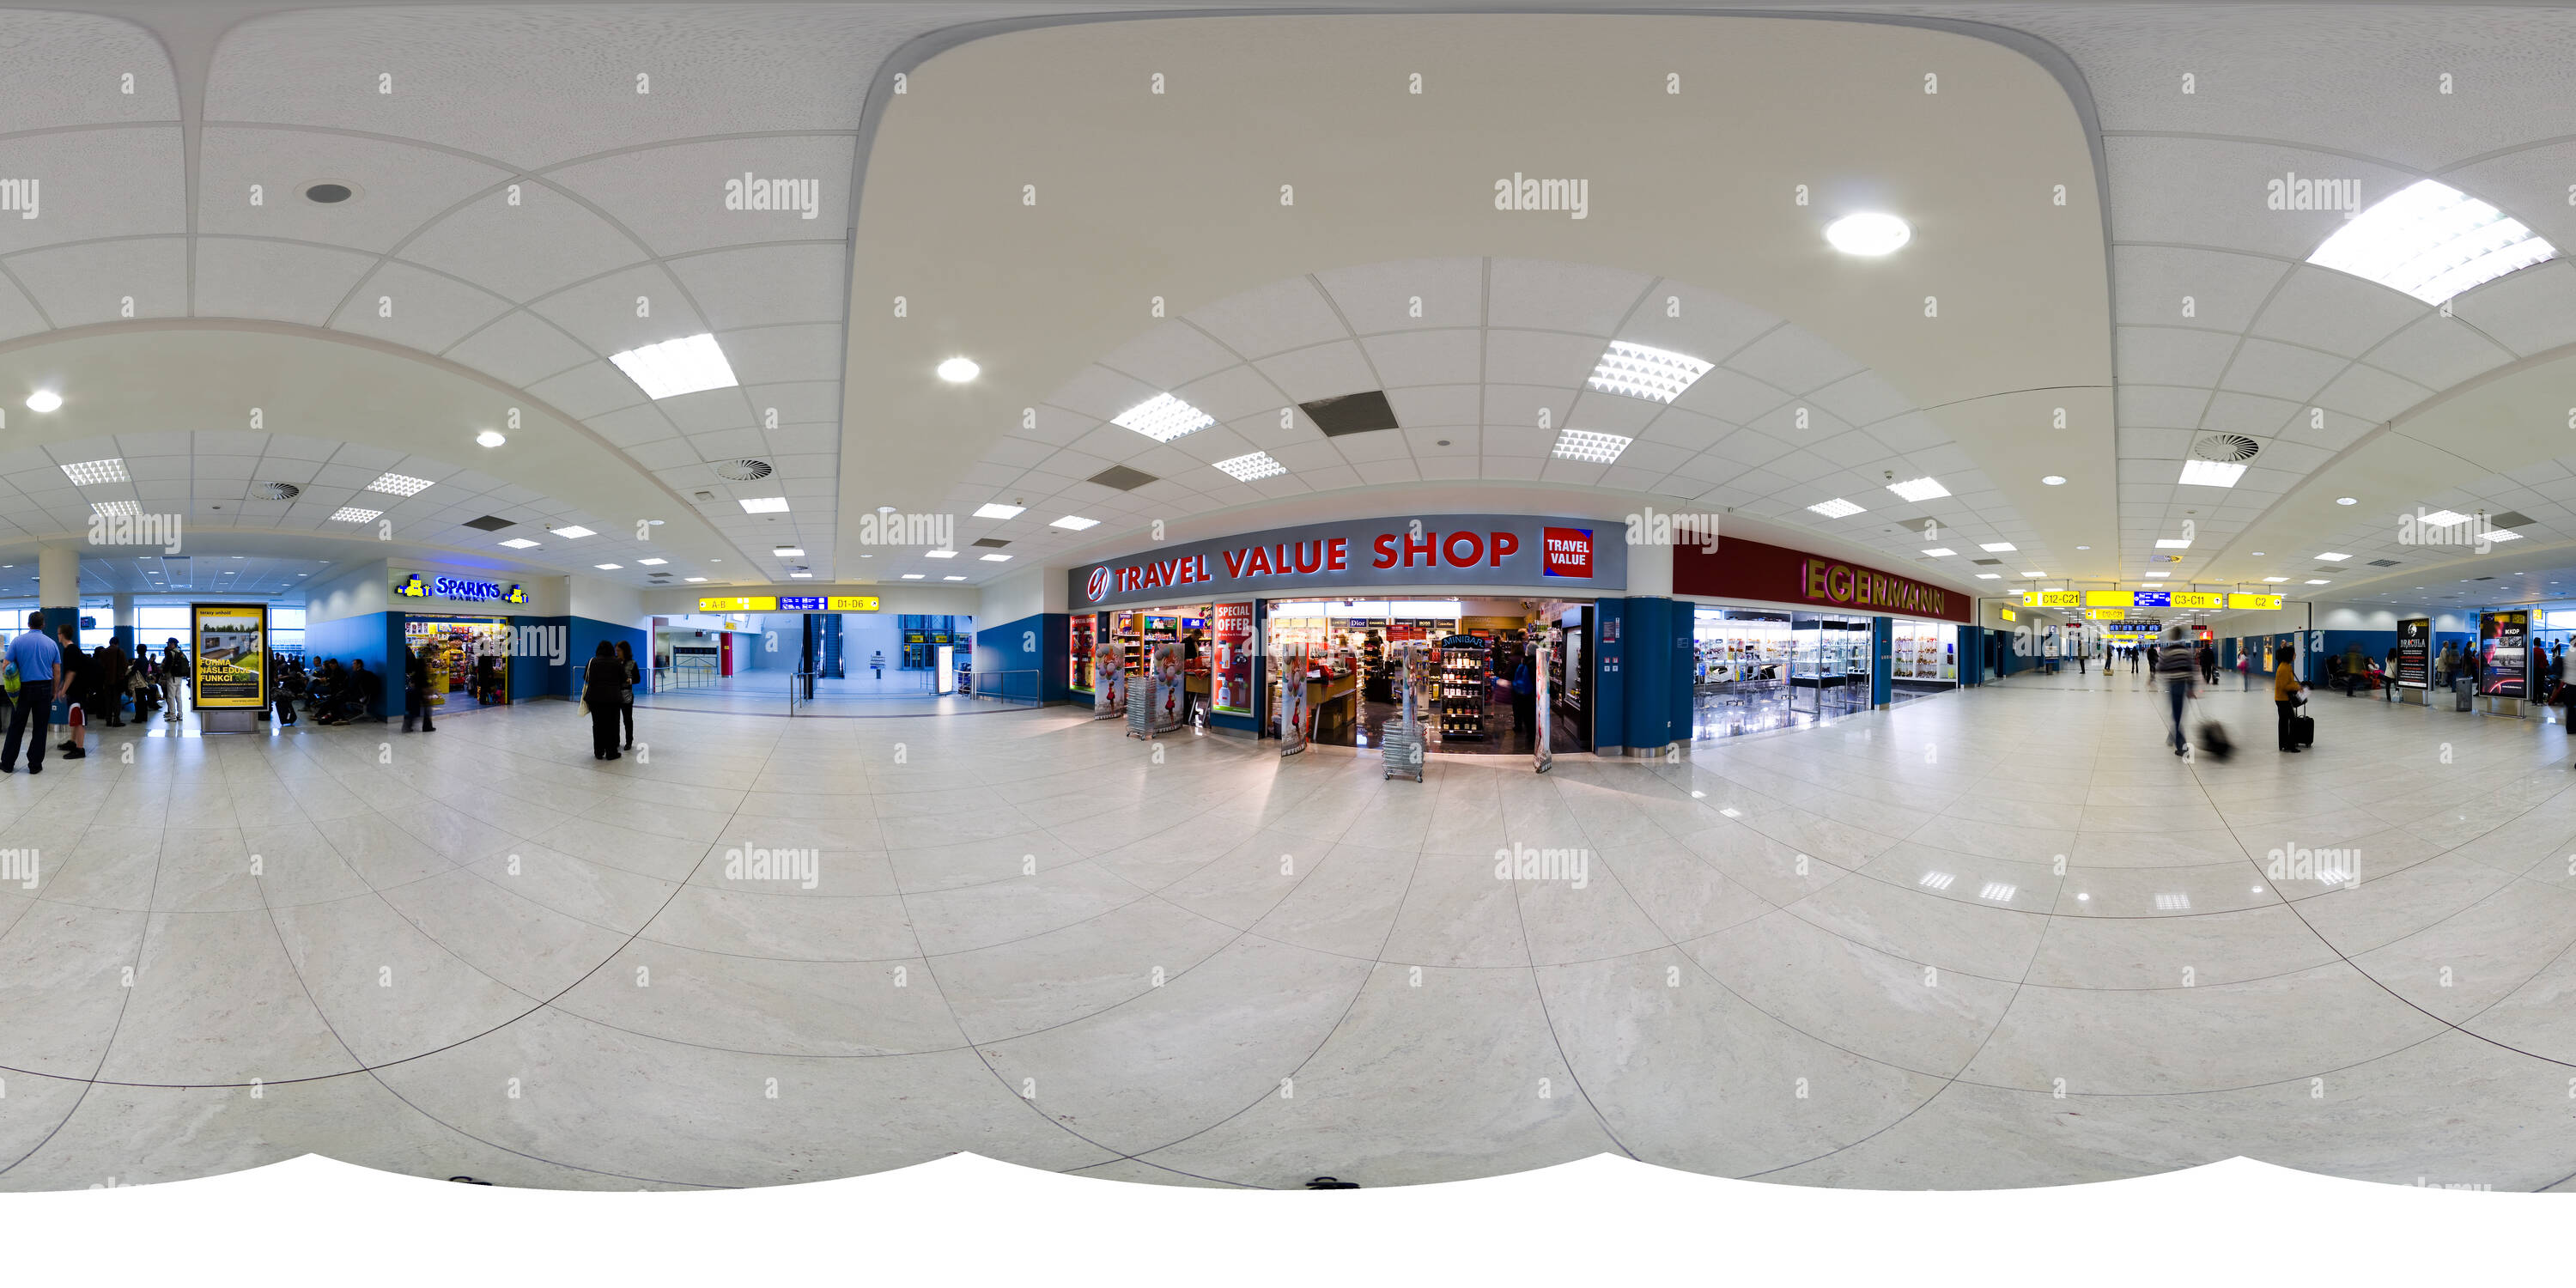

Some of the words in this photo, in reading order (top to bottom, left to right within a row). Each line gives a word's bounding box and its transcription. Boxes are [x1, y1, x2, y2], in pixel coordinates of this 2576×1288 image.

[1547, 538, 1589, 553] TRAVEL
[1115, 554, 1212, 593] TRAVEL
[1223, 538, 1348, 579] VALUE
[1372, 531, 1519, 569] SHOP
[1551, 553, 1586, 565] VALUE
[436, 577, 501, 598] SPARKYS
[1805, 559, 1944, 615] EGERMANN
[837, 599, 864, 608] D1-D6
[2043, 594, 2079, 604] C12-C21
[2175, 595, 2204, 605] C3-C11
[2256, 598, 2266, 606] C2
[1218, 605, 1250, 617] SPECIAL
[1218, 618, 1250, 631] OFFER
[1443, 635, 1484, 648] MINIBAR
[2400, 638, 2426, 647] DRACULA
[200, 665, 252, 674] NÁSLEDUJE
